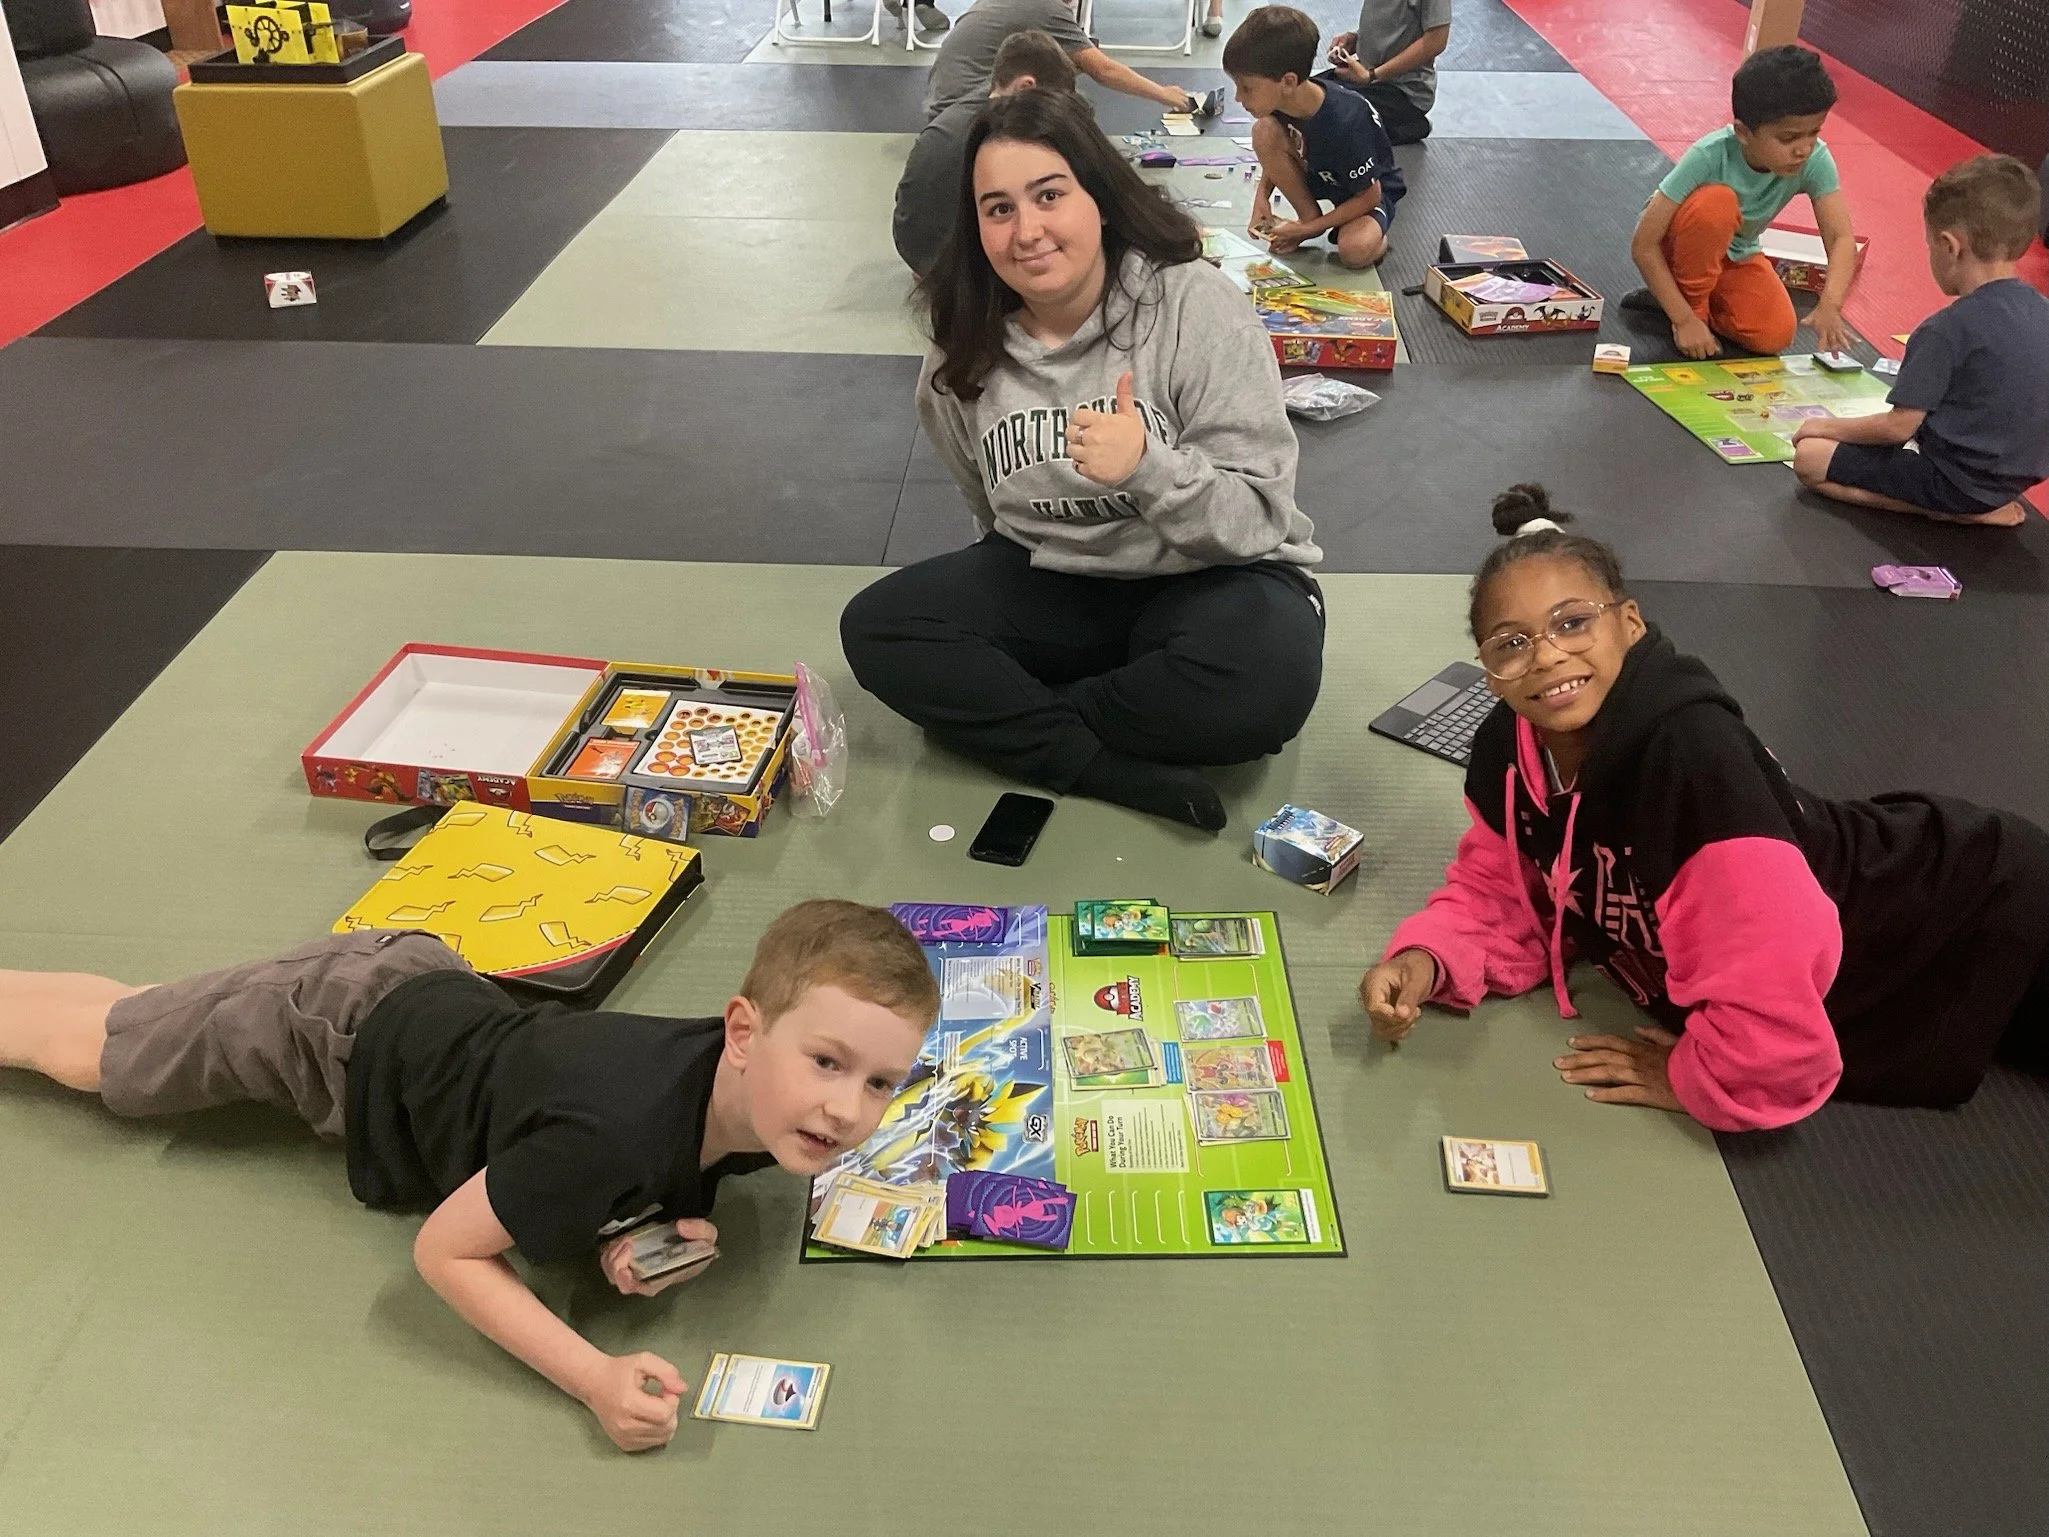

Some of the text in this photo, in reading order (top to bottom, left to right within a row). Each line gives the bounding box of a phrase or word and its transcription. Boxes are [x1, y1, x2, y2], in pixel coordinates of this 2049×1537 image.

[1349, 157, 1374, 179] GOAT
[981, 407, 1072, 493] NORTH
[1128, 975, 1143, 1021] ACADEMY
[1008, 1039, 1018, 1057] SPOT
[1019, 1036, 1028, 1061] ACTIVE
[1028, 1115, 1043, 1141] GX
[1106, 1115, 1118, 1169] What You Can Do
[1116, 1116, 1127, 1169] During Your Turn
